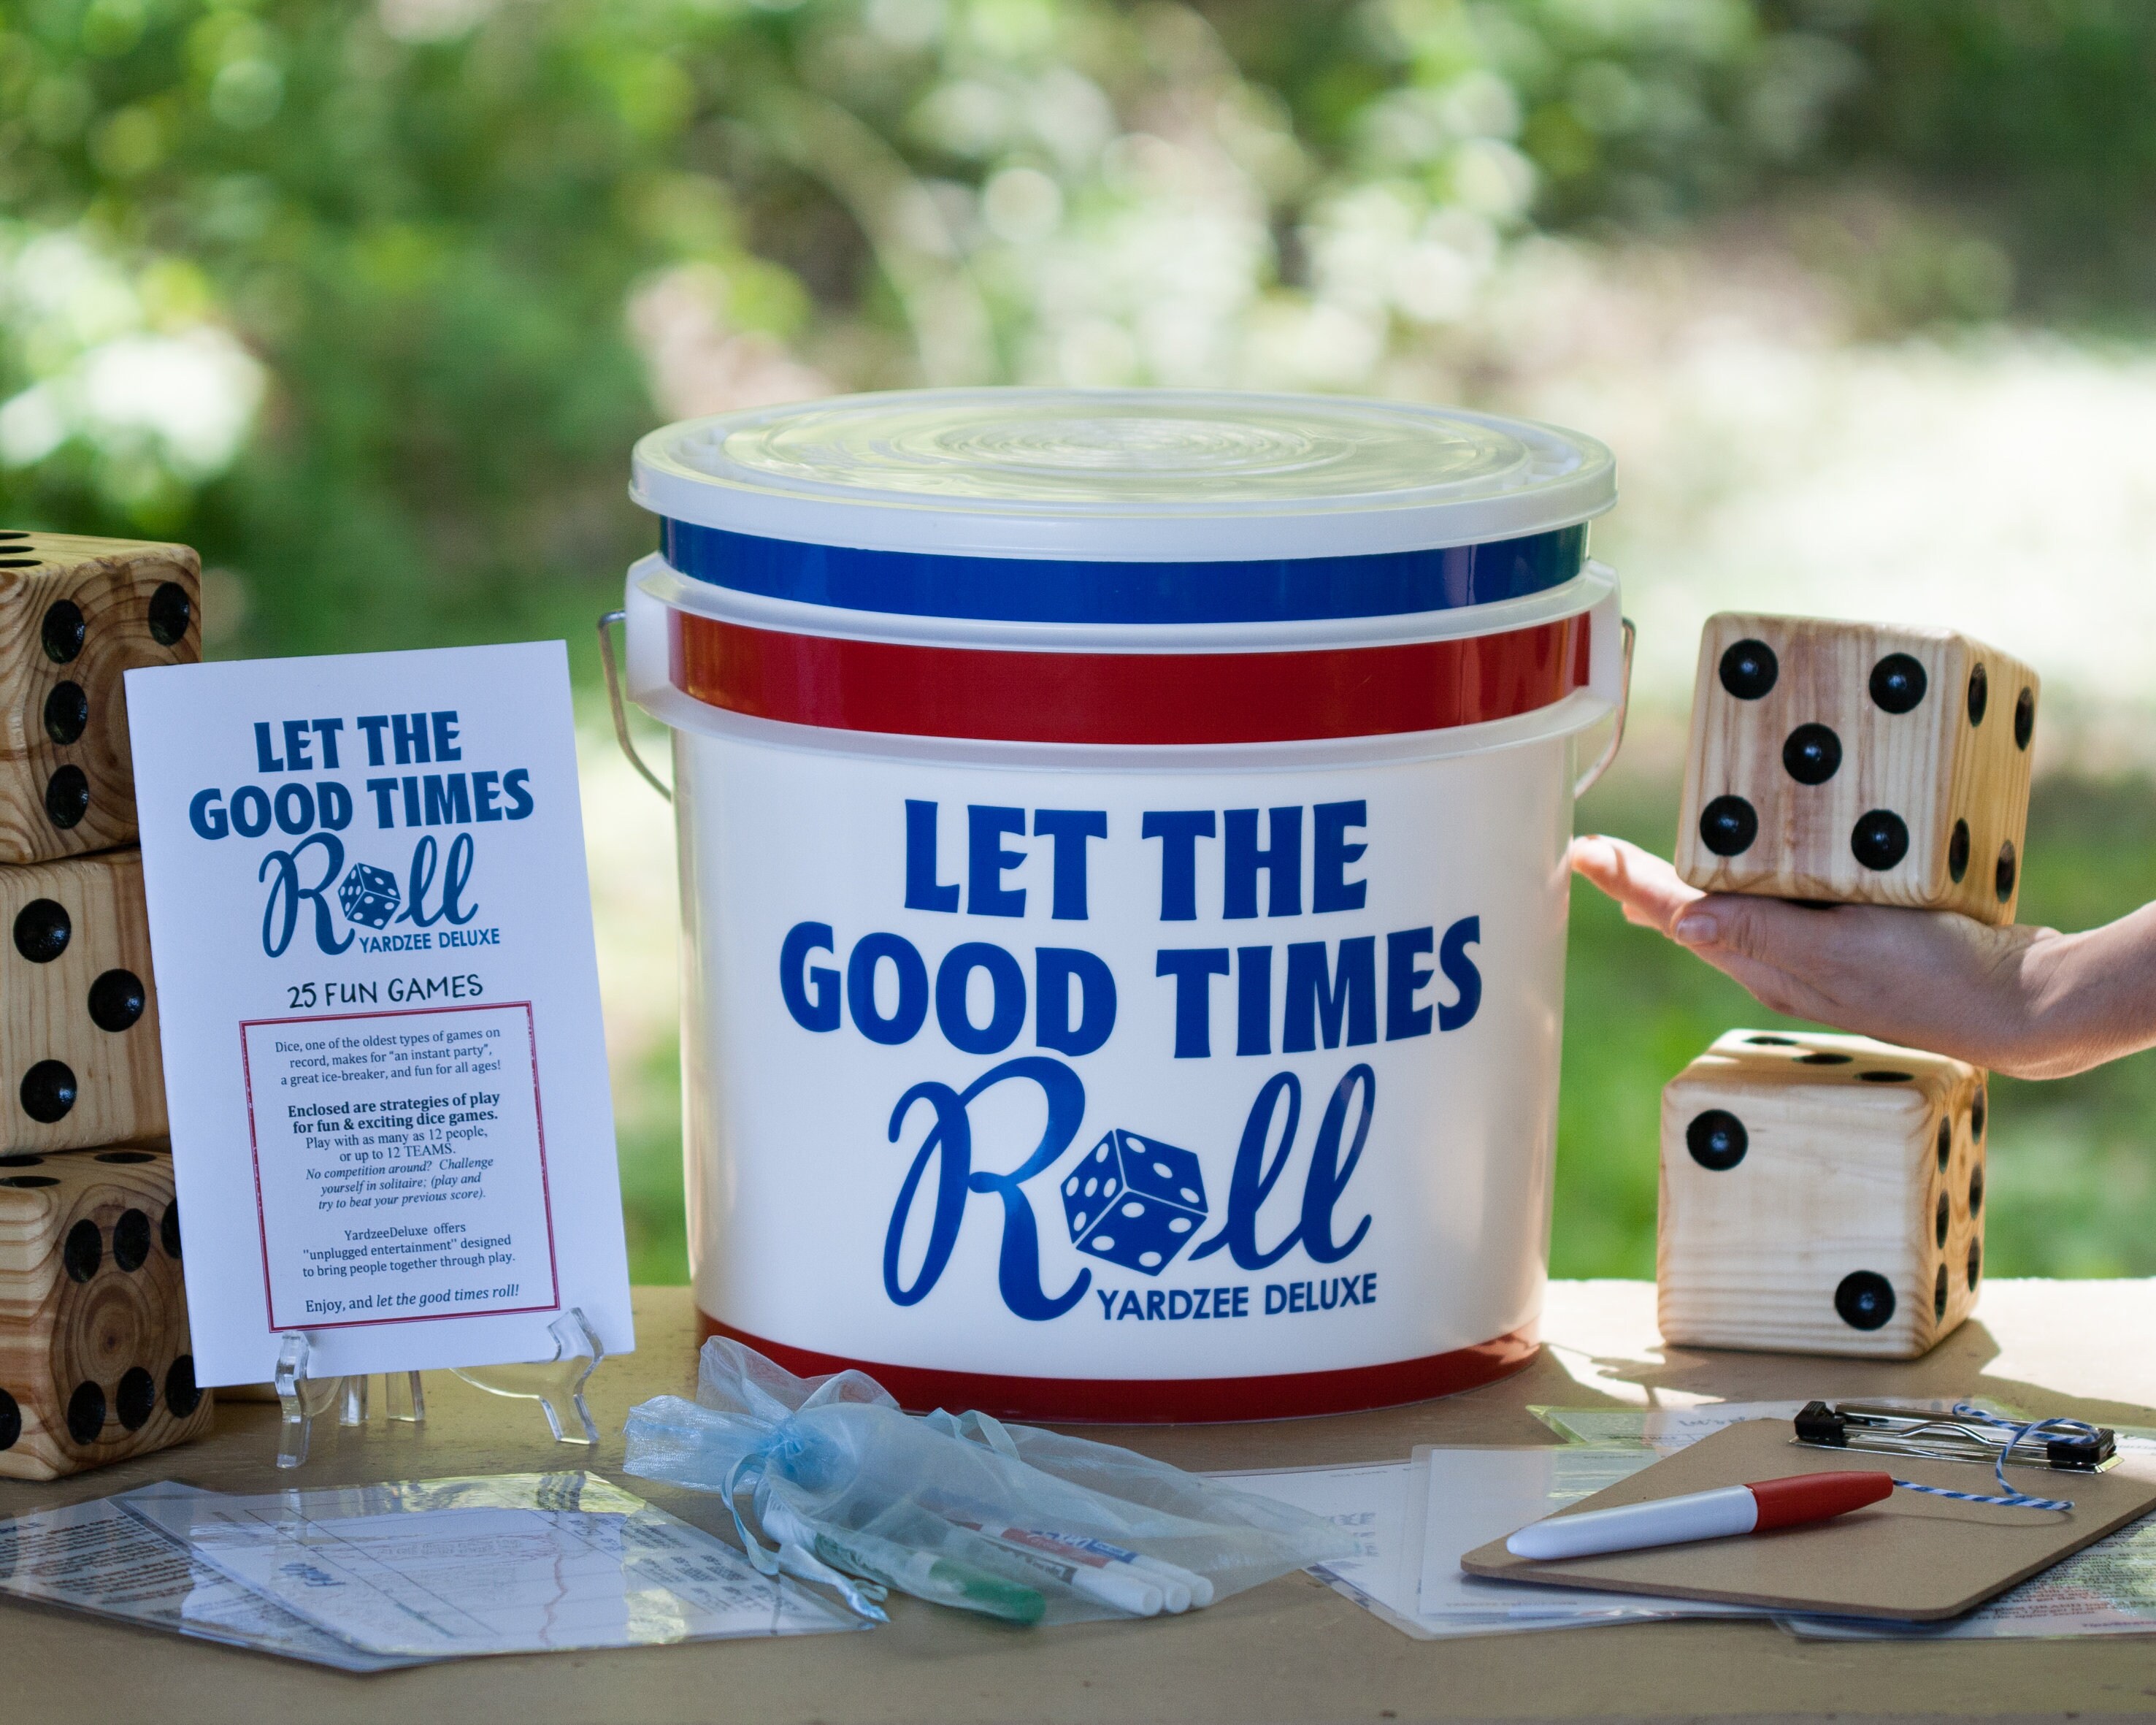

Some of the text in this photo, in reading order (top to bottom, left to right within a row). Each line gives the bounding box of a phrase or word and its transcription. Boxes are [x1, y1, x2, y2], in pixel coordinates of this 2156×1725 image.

[253, 711, 461, 773] LET THE
[189, 768, 534, 840] GOOD TIMES
[905, 799, 1368, 921] LET THE
[358, 928, 500, 953] YARDZEE DELUXE
[288, 974, 483, 1009] 25 FUN GAMES
[780, 915, 1482, 1059] GOOD TIMES
[275, 1029, 501, 1053] Dice, one of the oldest types of games on
[289, 1055, 329, 1068] record,
[331, 1053, 368, 1066] makes
[370, 1051, 387, 1063] for
[411, 1048, 450, 1060] instant
[280, 1059, 501, 1087] a great ice-breaker, and fun for all ages!
[287, 1091, 501, 1118] Enclosed are strategies of play
[293, 1110, 499, 1134] for fun & exciting dice games.
[305, 1125, 488, 1151] Play with as many as 12 people,
[339, 1142, 456, 1164] or up to 12 TEAMS.
[305, 1157, 494, 1180] No competition around? Challenge
[320, 1179, 366, 1198] yourself
[366, 1180, 377, 1191] in
[431, 1174, 459, 1189] (play
[460, 1171, 482, 1185] and
[318, 1187, 486, 1212] try to beat your previous score).
[344, 1222, 467, 1241] YardzeeDeluxe offers
[460, 1233, 512, 1250] designed
[302, 1251, 515, 1277] to bring people together through play.
[305, 1283, 519, 1315] Enjoy, and let the good times roll!
[1097, 1272, 1377, 1320] YARDZEE DELUXE
